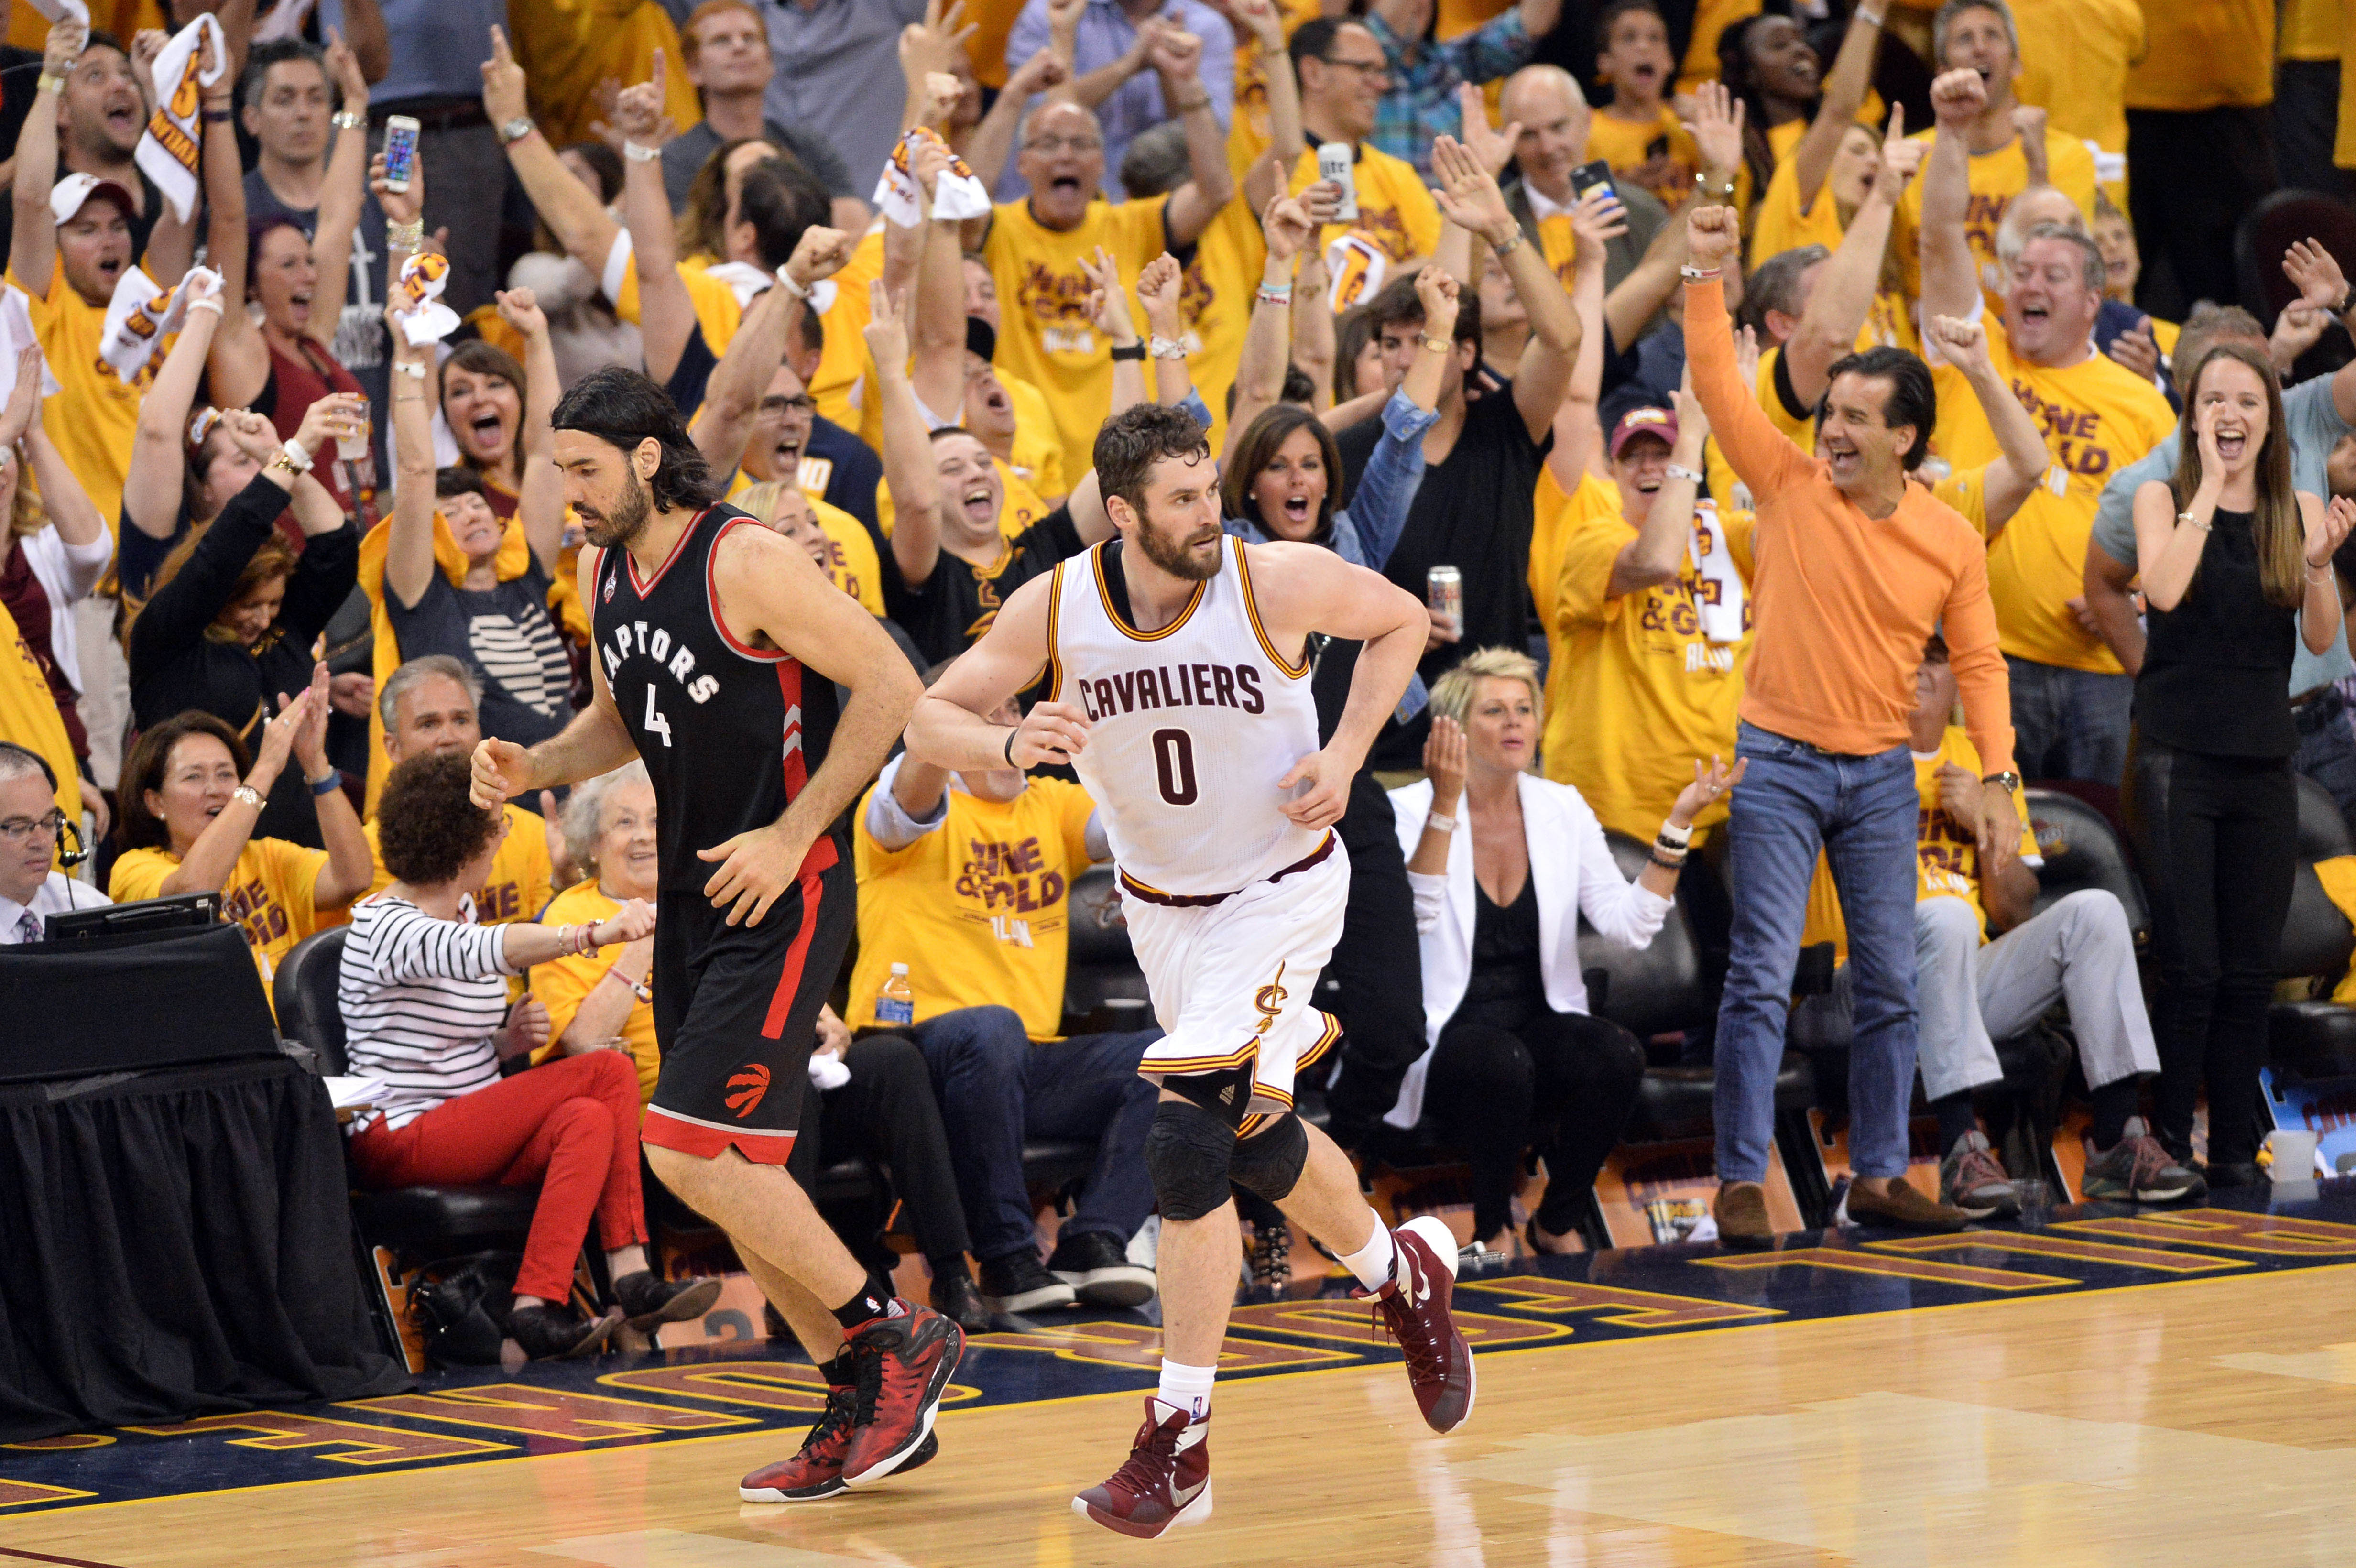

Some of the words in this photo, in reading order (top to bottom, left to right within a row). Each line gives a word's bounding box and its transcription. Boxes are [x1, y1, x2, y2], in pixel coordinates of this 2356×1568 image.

[603, 621, 720, 704] APTORS
[1079, 664, 1265, 722] CAVALIERS
[645, 683, 672, 747] 4
[1152, 728, 1198, 806] 0
